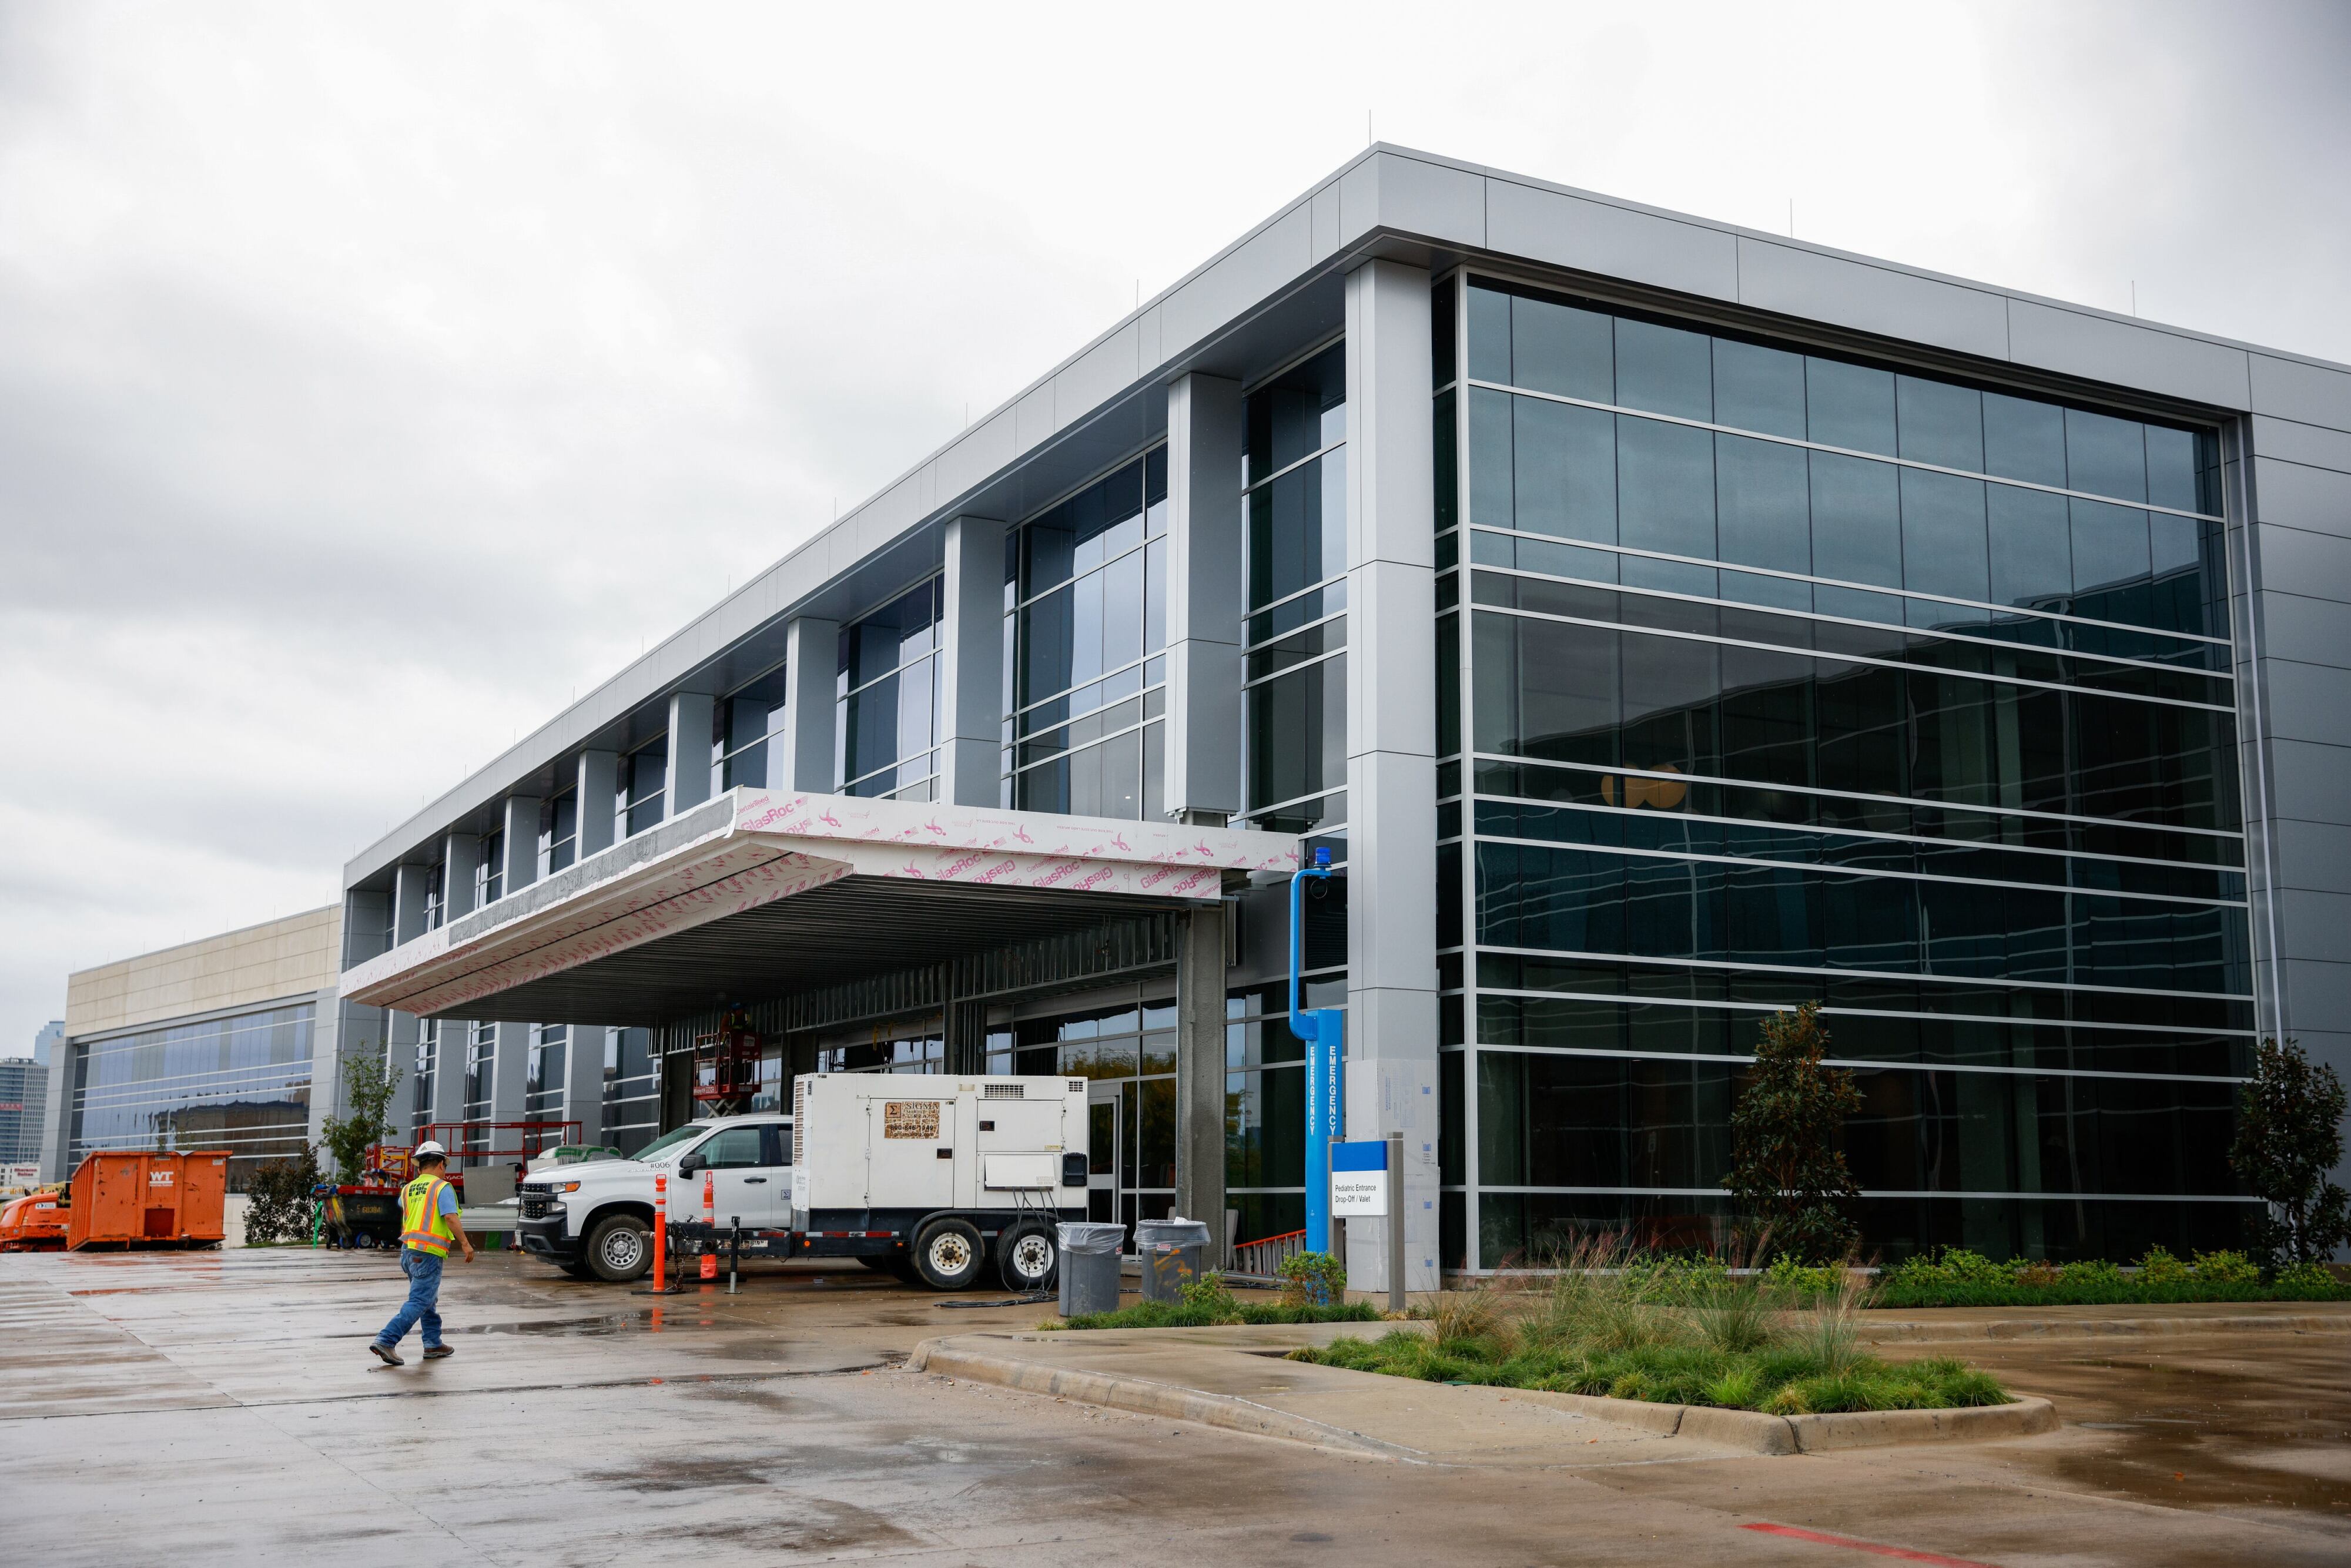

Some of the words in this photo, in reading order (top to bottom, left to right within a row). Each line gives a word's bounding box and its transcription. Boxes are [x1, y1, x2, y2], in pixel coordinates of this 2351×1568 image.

[741, 803, 794, 830] GlasRoc
[1033, 862, 1080, 887] GlasRoc
[1140, 865, 1179, 889] GlasRo
[1173, 869, 1217, 894] GlasRoc
[150, 1171, 174, 1181] WT
[1335, 1195, 1355, 1204] Drop-Off
